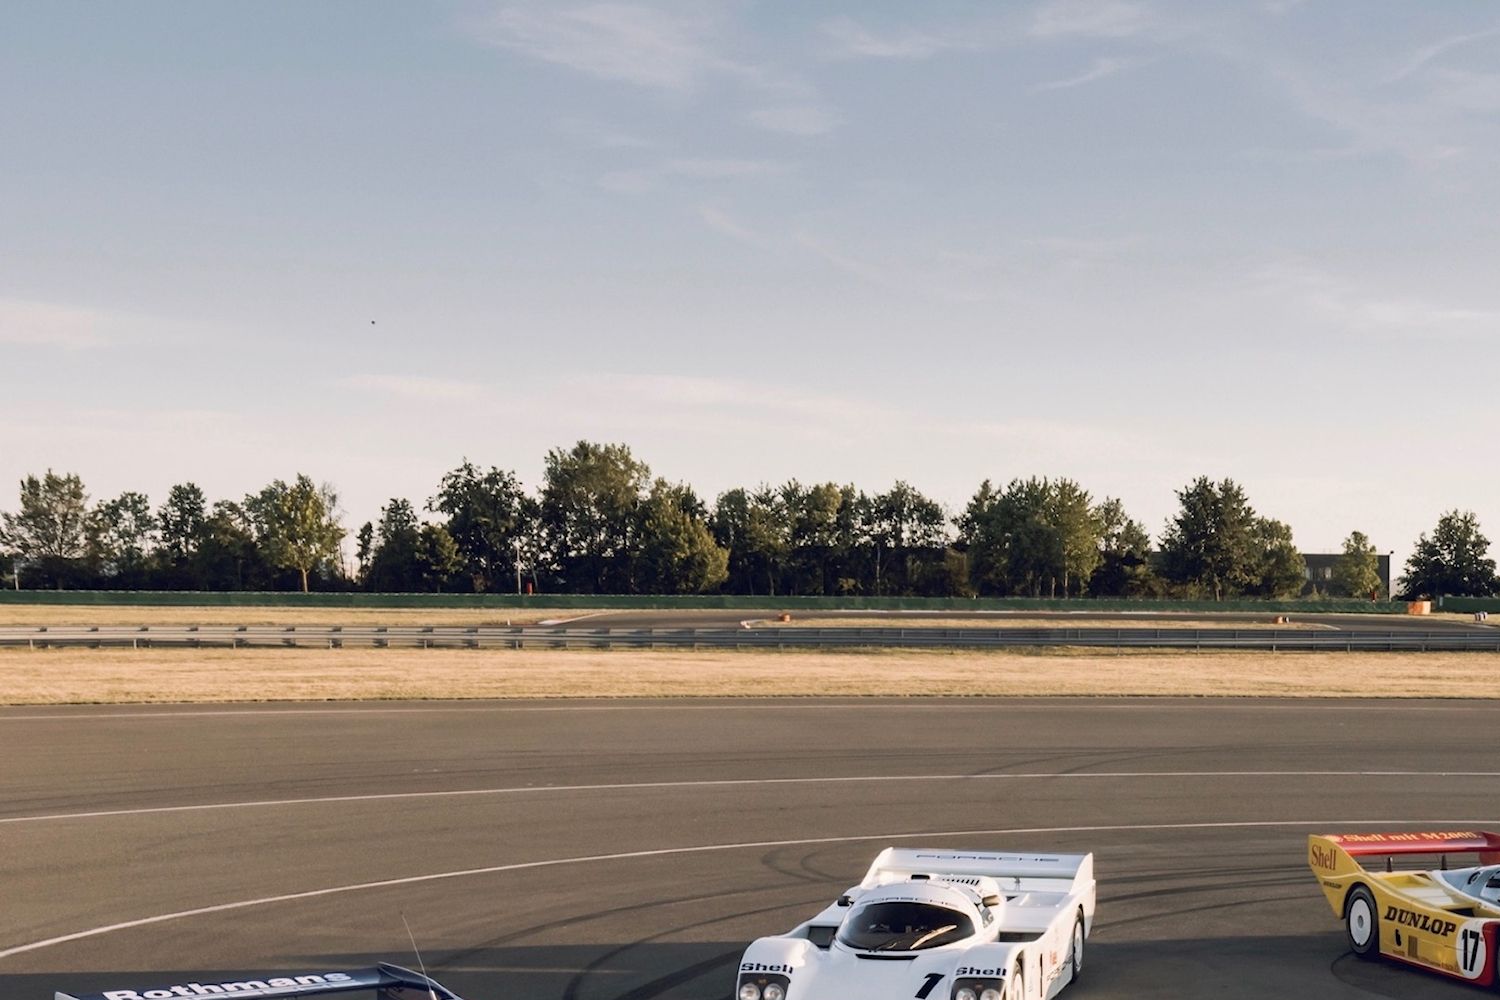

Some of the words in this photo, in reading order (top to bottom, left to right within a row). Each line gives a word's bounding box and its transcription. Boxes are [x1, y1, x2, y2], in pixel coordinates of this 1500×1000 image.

[1311, 844, 1337, 871] Shell
[1384, 906, 1457, 937] DUNLOP
[1462, 928, 1480, 972] 17
[741, 963, 793, 974] Shell
[956, 966, 1007, 976] Shell
[914, 972, 946, 1000] 1
